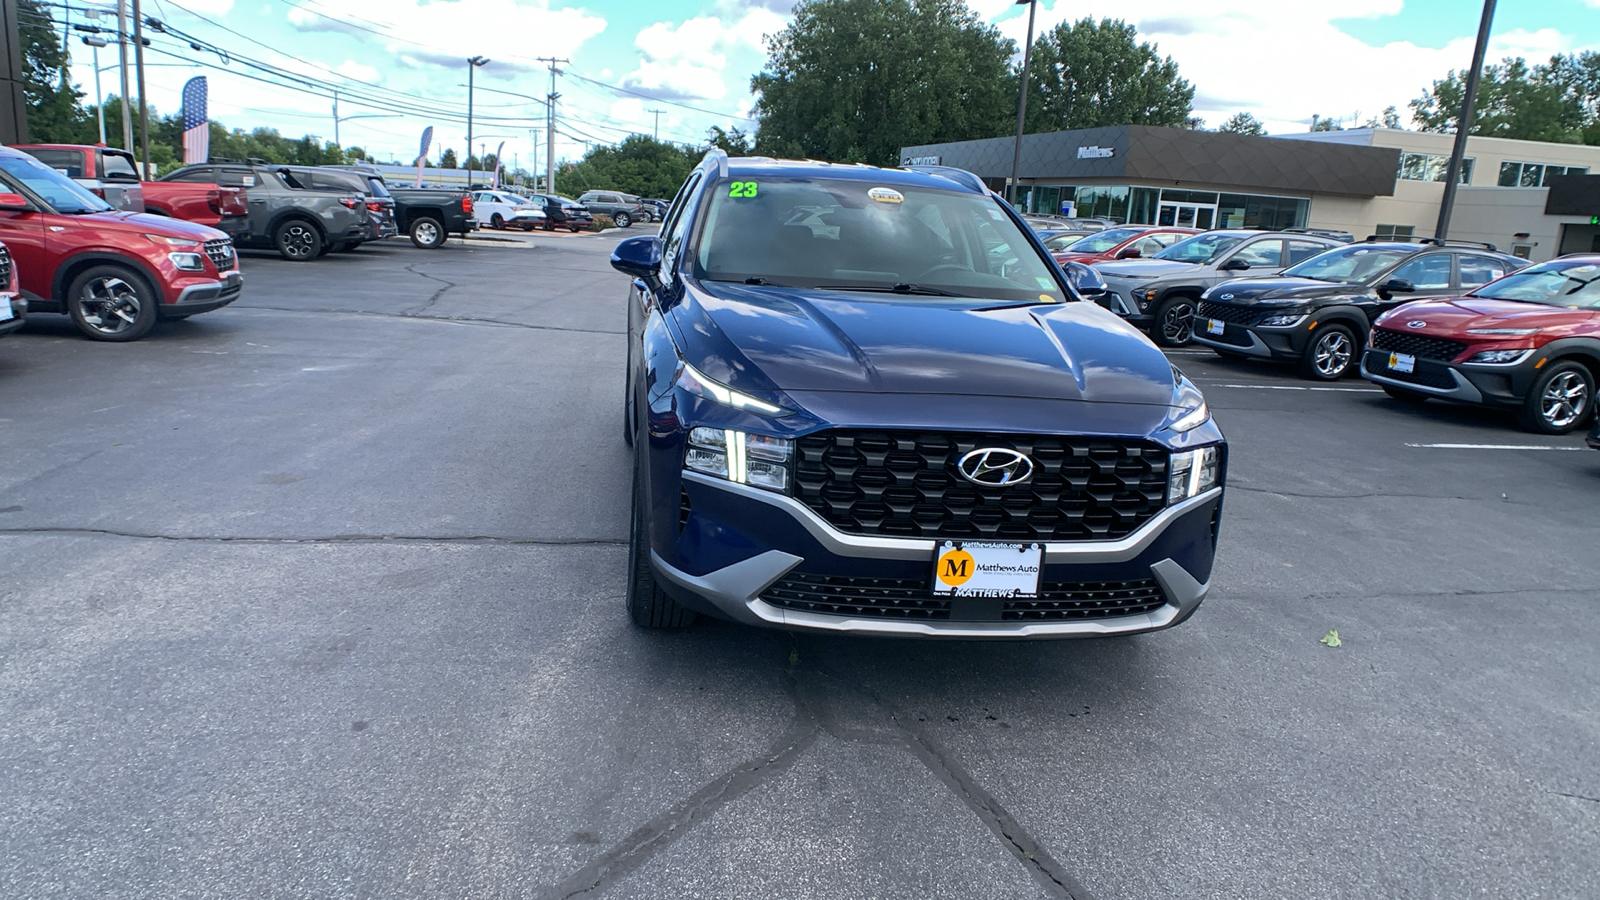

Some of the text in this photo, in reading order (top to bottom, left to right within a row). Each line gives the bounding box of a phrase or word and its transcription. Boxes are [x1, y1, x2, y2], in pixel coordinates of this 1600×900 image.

[1077, 146, 1114, 158] Matthews
[729, 181, 757, 198] 23
[961, 541, 1023, 550] MatthewsAuto.com
[943, 559, 969, 577] M
[976, 563, 1038, 573] Matthews Auto
[955, 588, 1014, 599] MATTHEWS
